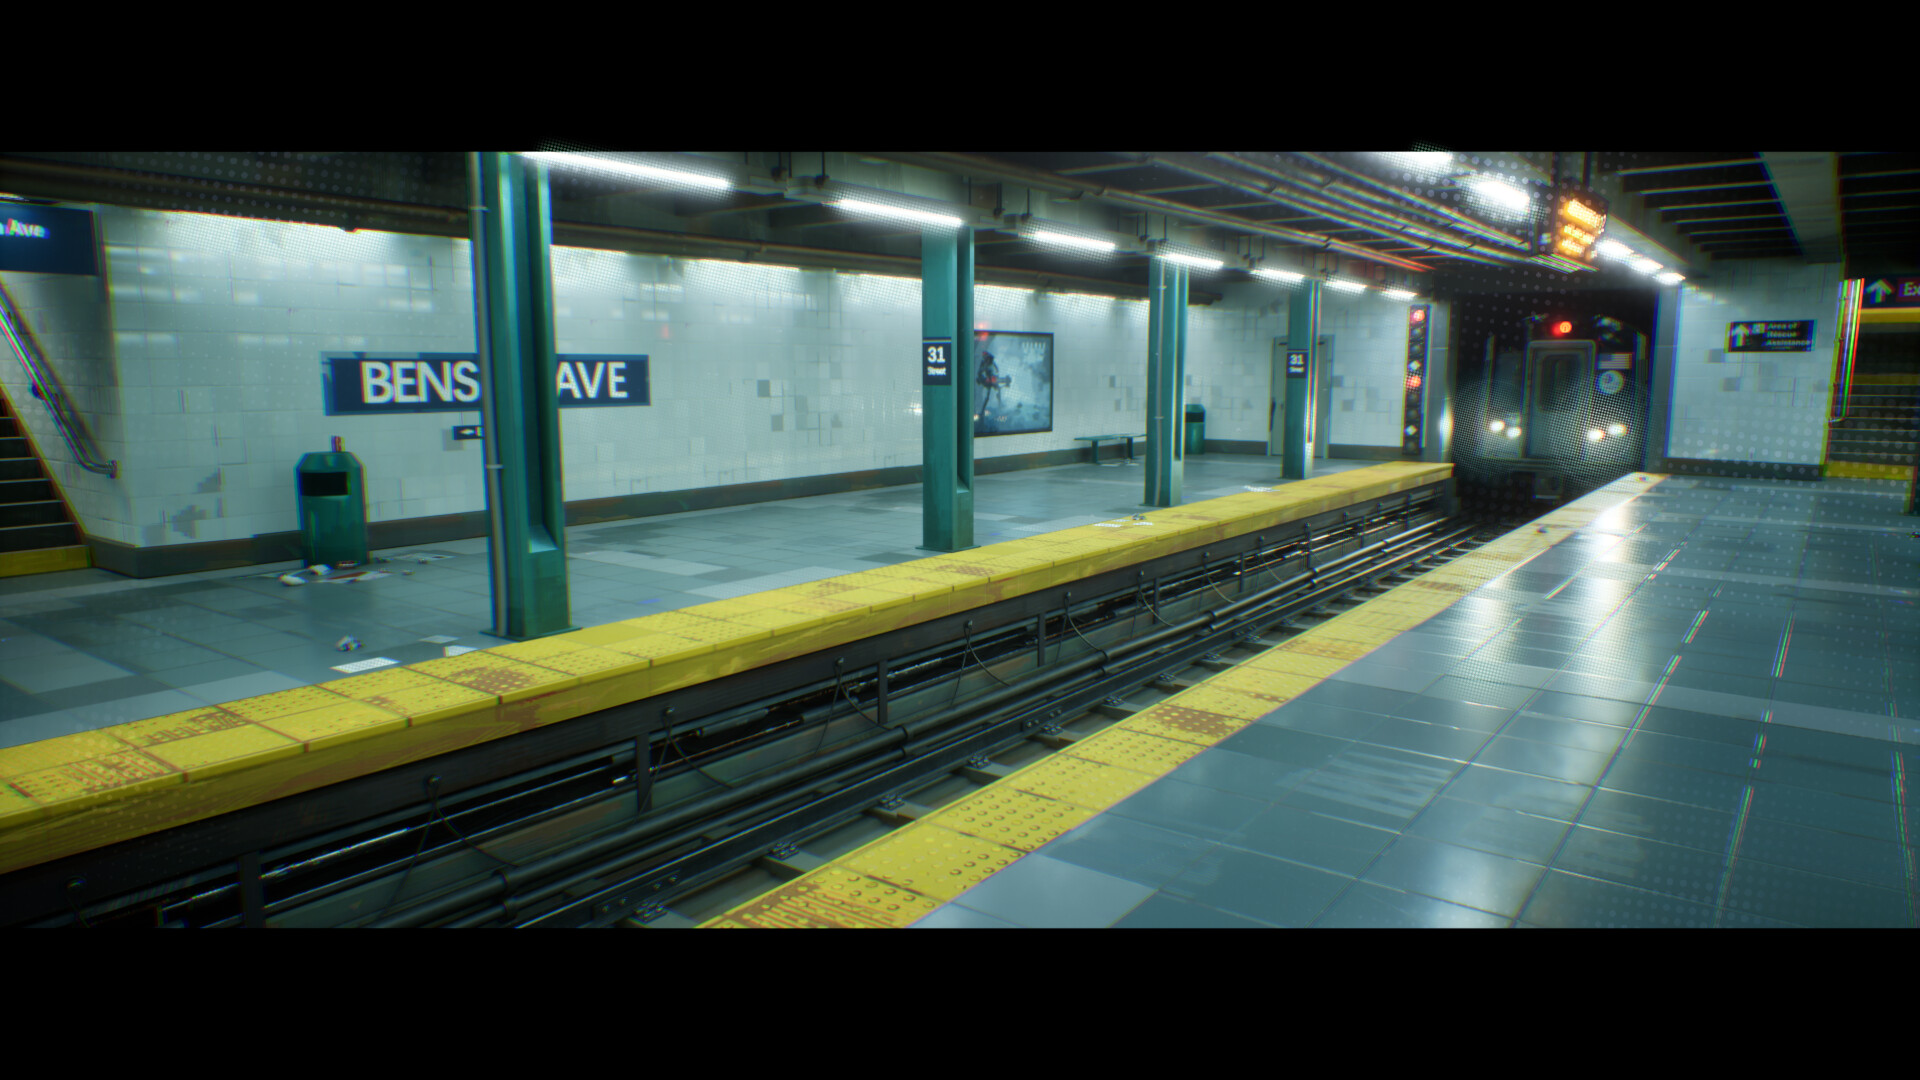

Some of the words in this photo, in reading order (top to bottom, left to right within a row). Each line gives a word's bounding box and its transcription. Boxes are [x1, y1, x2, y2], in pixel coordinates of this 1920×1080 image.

[6, 218, 49, 239] Ave
[1767, 322, 1787, 330] Area
[927, 346, 946, 364] 31
[1289, 353, 1304, 366] 31
[926, 366, 947, 376] Street
[556, 361, 629, 399] AVE
